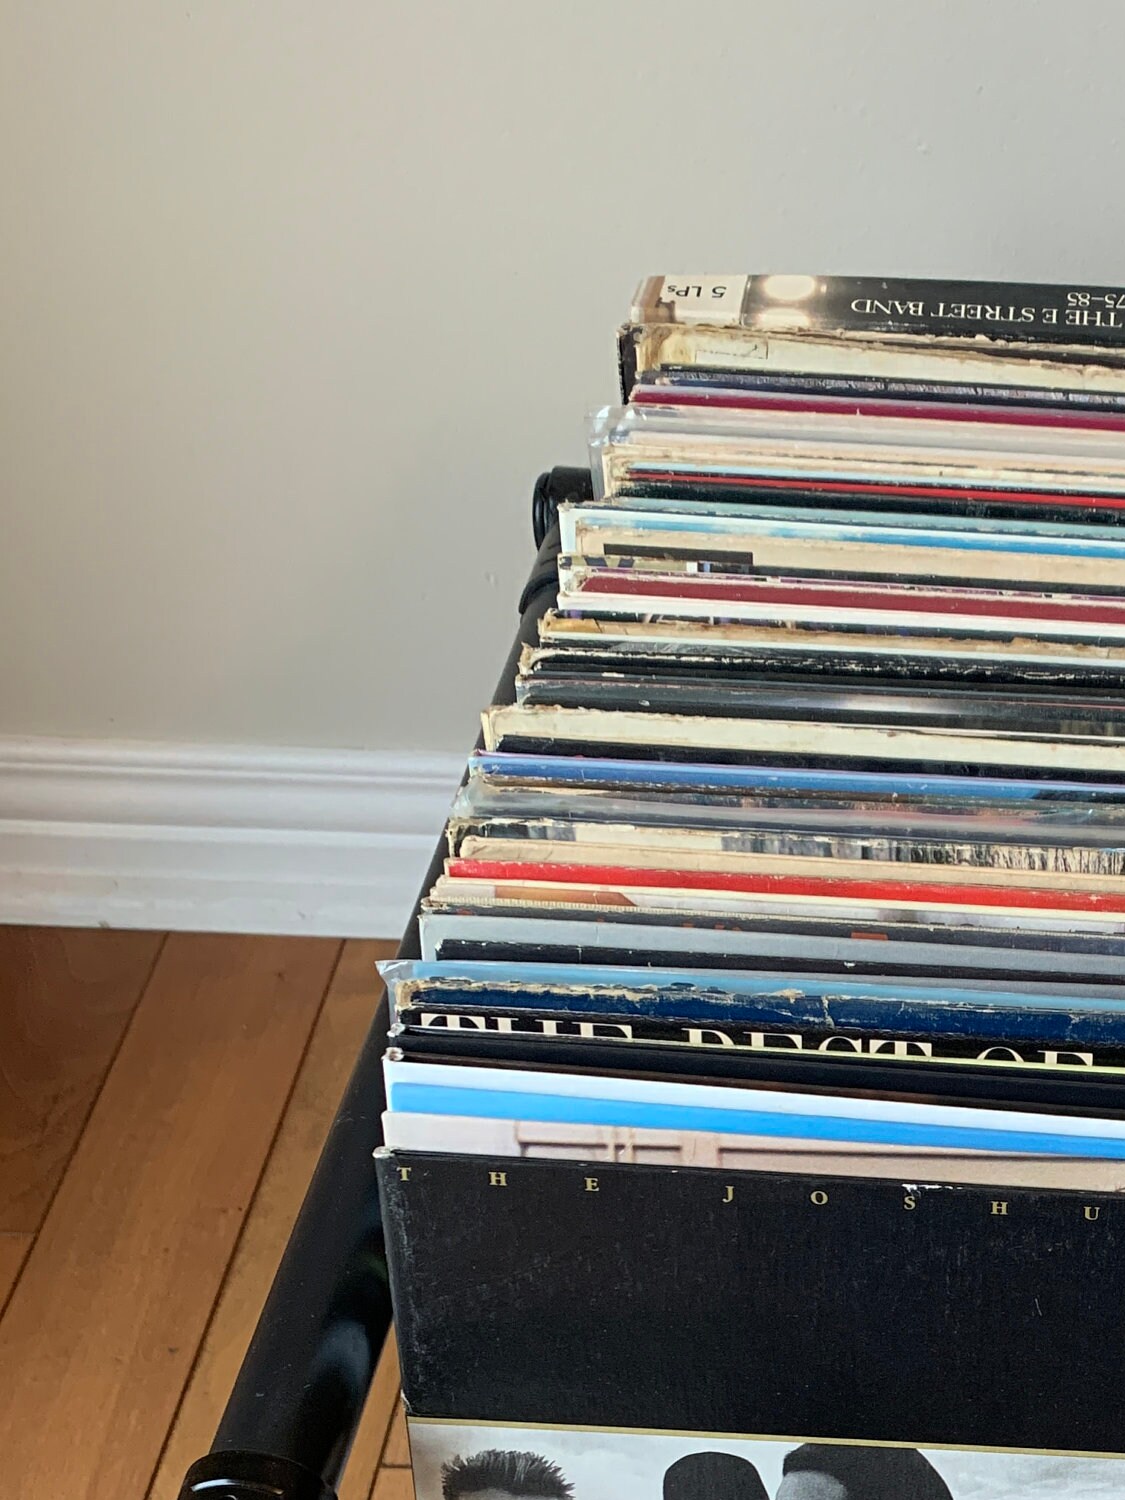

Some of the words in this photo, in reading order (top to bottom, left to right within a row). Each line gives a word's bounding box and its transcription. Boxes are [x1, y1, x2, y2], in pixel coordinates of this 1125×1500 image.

[667, 285, 702, 298] LPs
[711, 286, 728, 298] 5
[851, 299, 924, 316] BAND
[930, 302, 1036, 322] STREET
[1042, 308, 1059, 324] E
[1065, 309, 1123, 328] THE
[397, 1167, 600, 1192] THE
